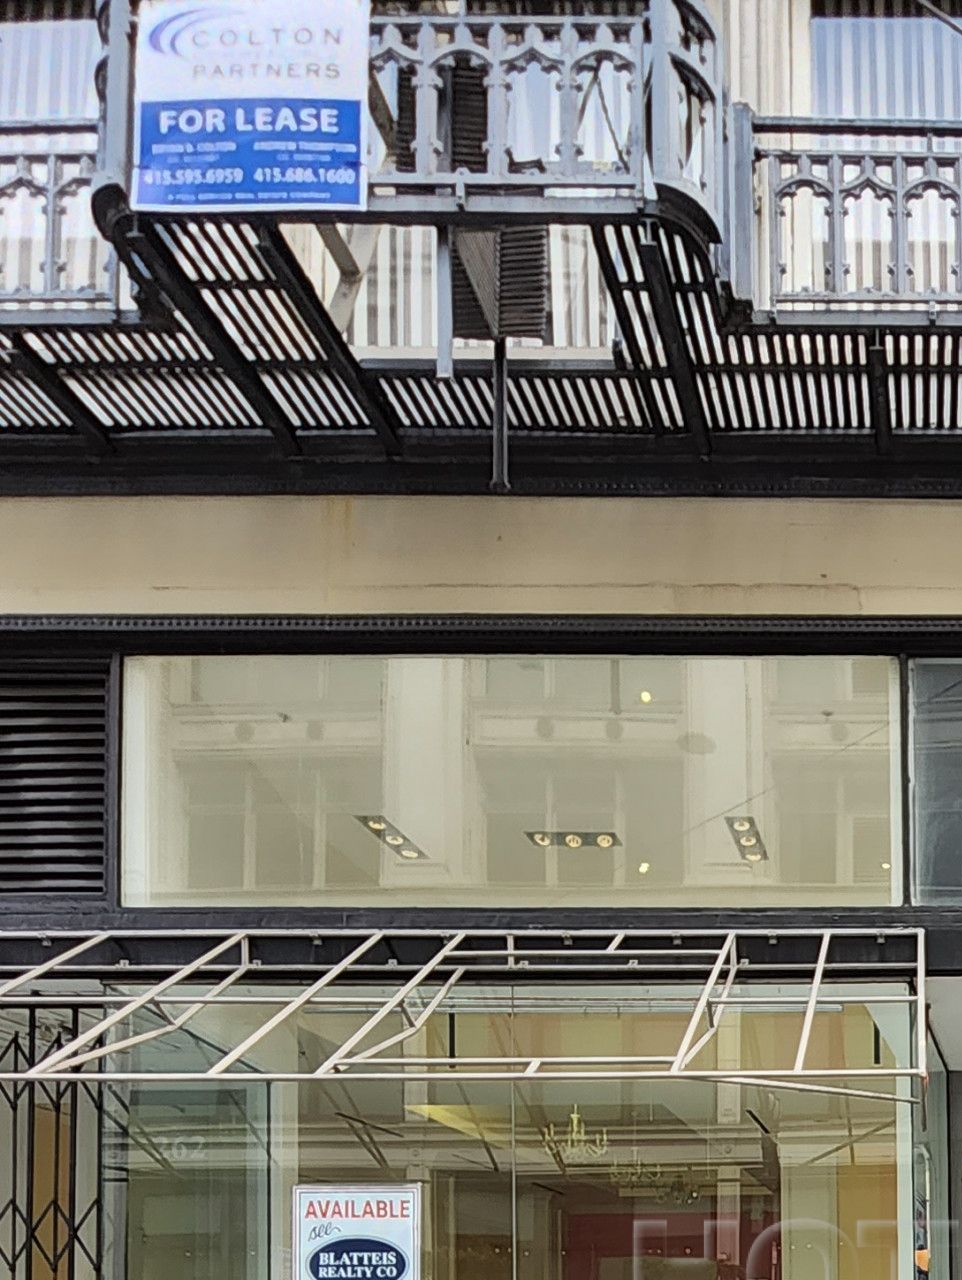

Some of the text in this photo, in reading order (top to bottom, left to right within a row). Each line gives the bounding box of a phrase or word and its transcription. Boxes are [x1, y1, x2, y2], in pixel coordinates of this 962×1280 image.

[192, 28, 342, 48] COLTON
[192, 63, 341, 80] PARTNERS
[159, 107, 340, 134] FOR LEASE
[144, 167, 244, 186] 415.595.6959
[253, 167, 356, 186] 415.686.1600
[304, 1199, 411, 1219] AVAILABLE
[319, 1251, 397, 1266] BLATTEIS
[318, 1266, 398, 1278] REALTY CO
